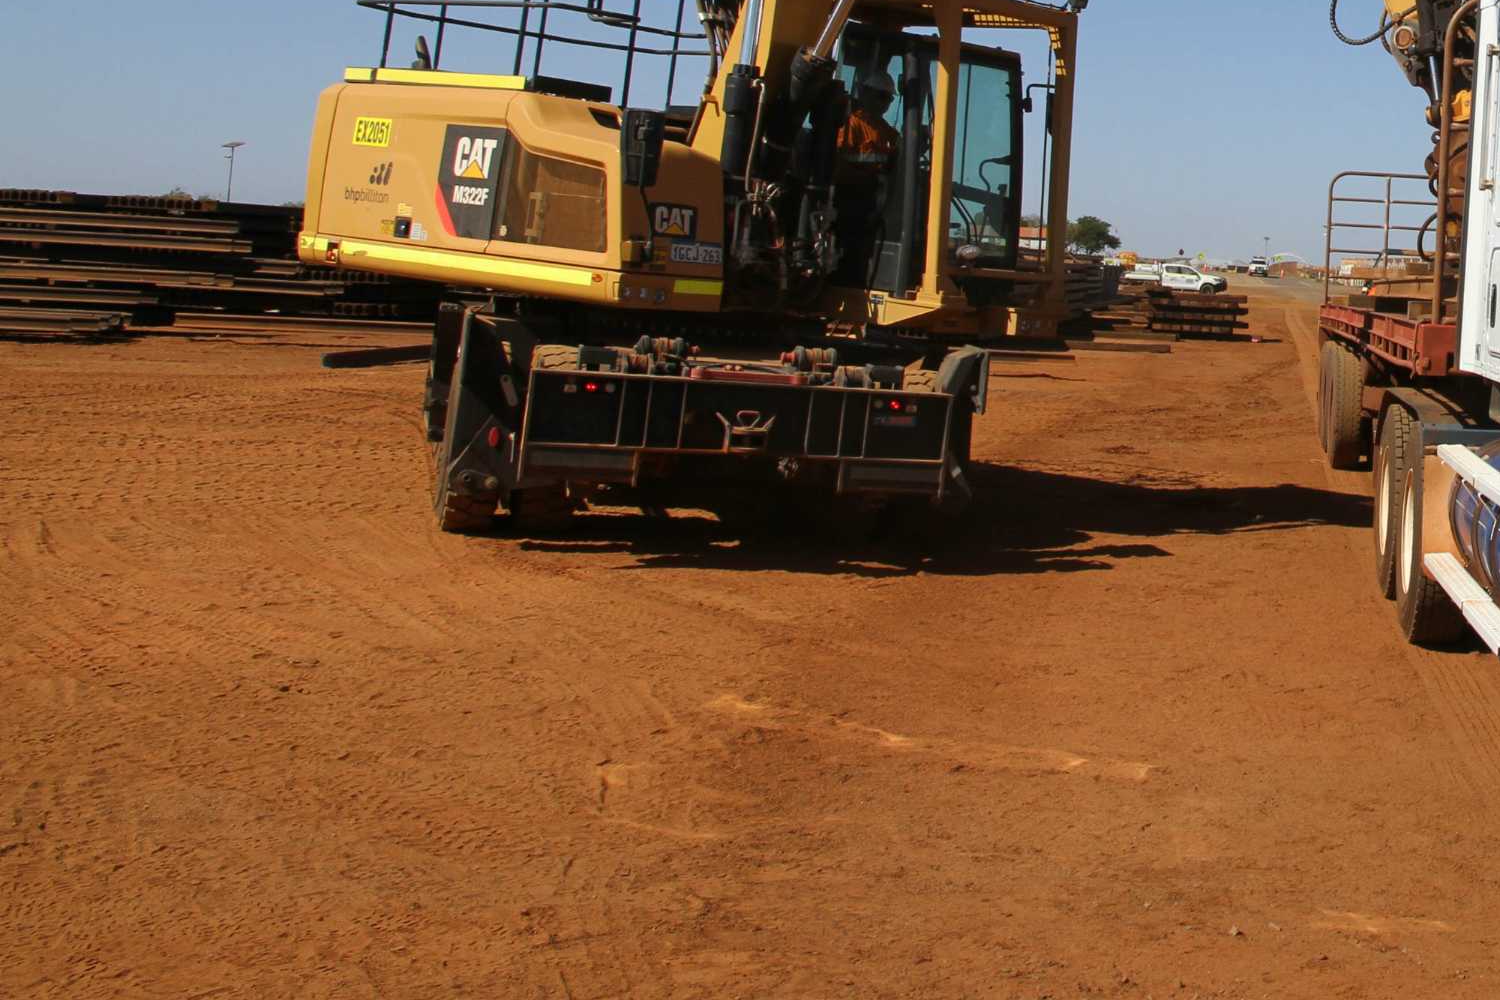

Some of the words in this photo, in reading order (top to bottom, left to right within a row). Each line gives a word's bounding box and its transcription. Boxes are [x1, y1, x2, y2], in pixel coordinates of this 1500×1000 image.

[355, 119, 391, 144] EX2051
[454, 136, 498, 179] CAT
[344, 186, 390, 204] bhpbilliton
[452, 184, 490, 206] M322F
[654, 206, 694, 236] CAT
